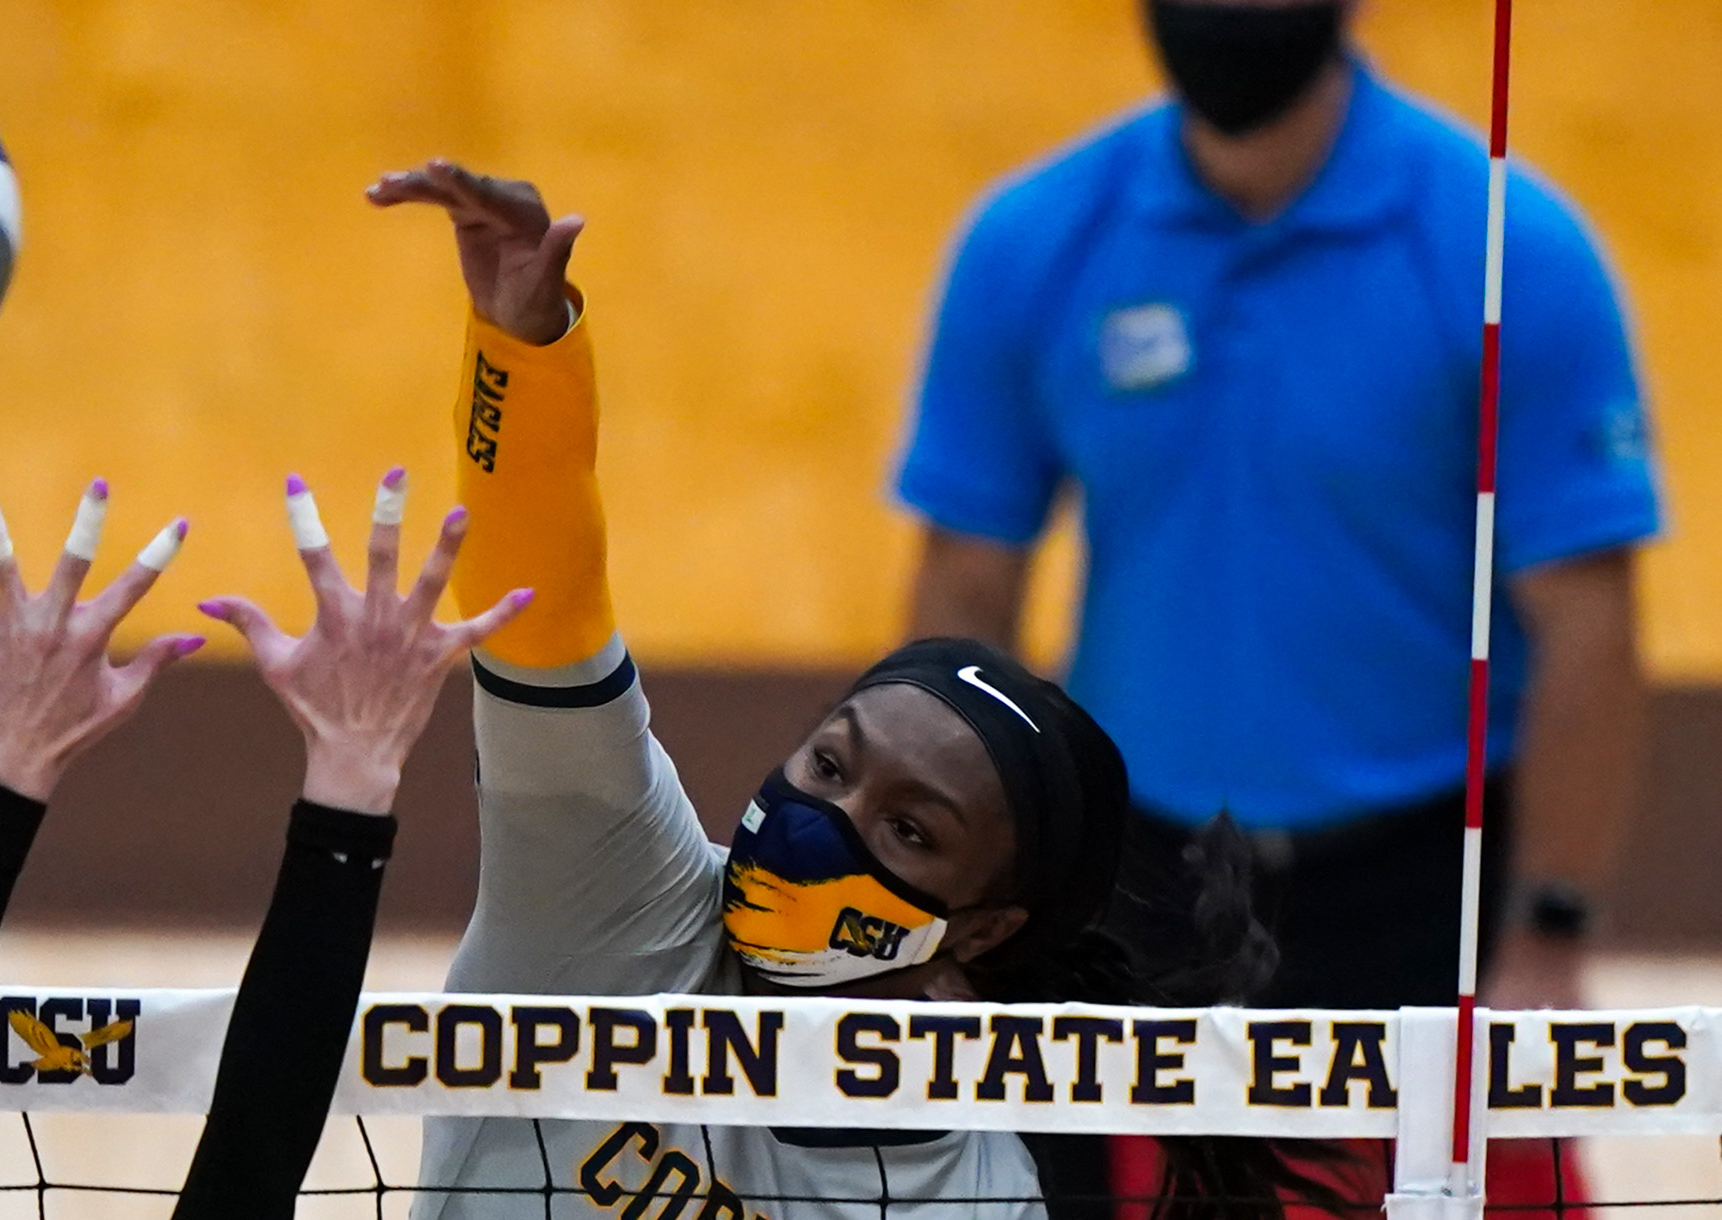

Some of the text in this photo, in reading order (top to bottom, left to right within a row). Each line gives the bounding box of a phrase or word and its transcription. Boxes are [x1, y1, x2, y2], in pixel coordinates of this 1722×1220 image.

[829, 905, 911, 961] CSU
[359, 1002, 1688, 1109] COPPIN STATE EALES
